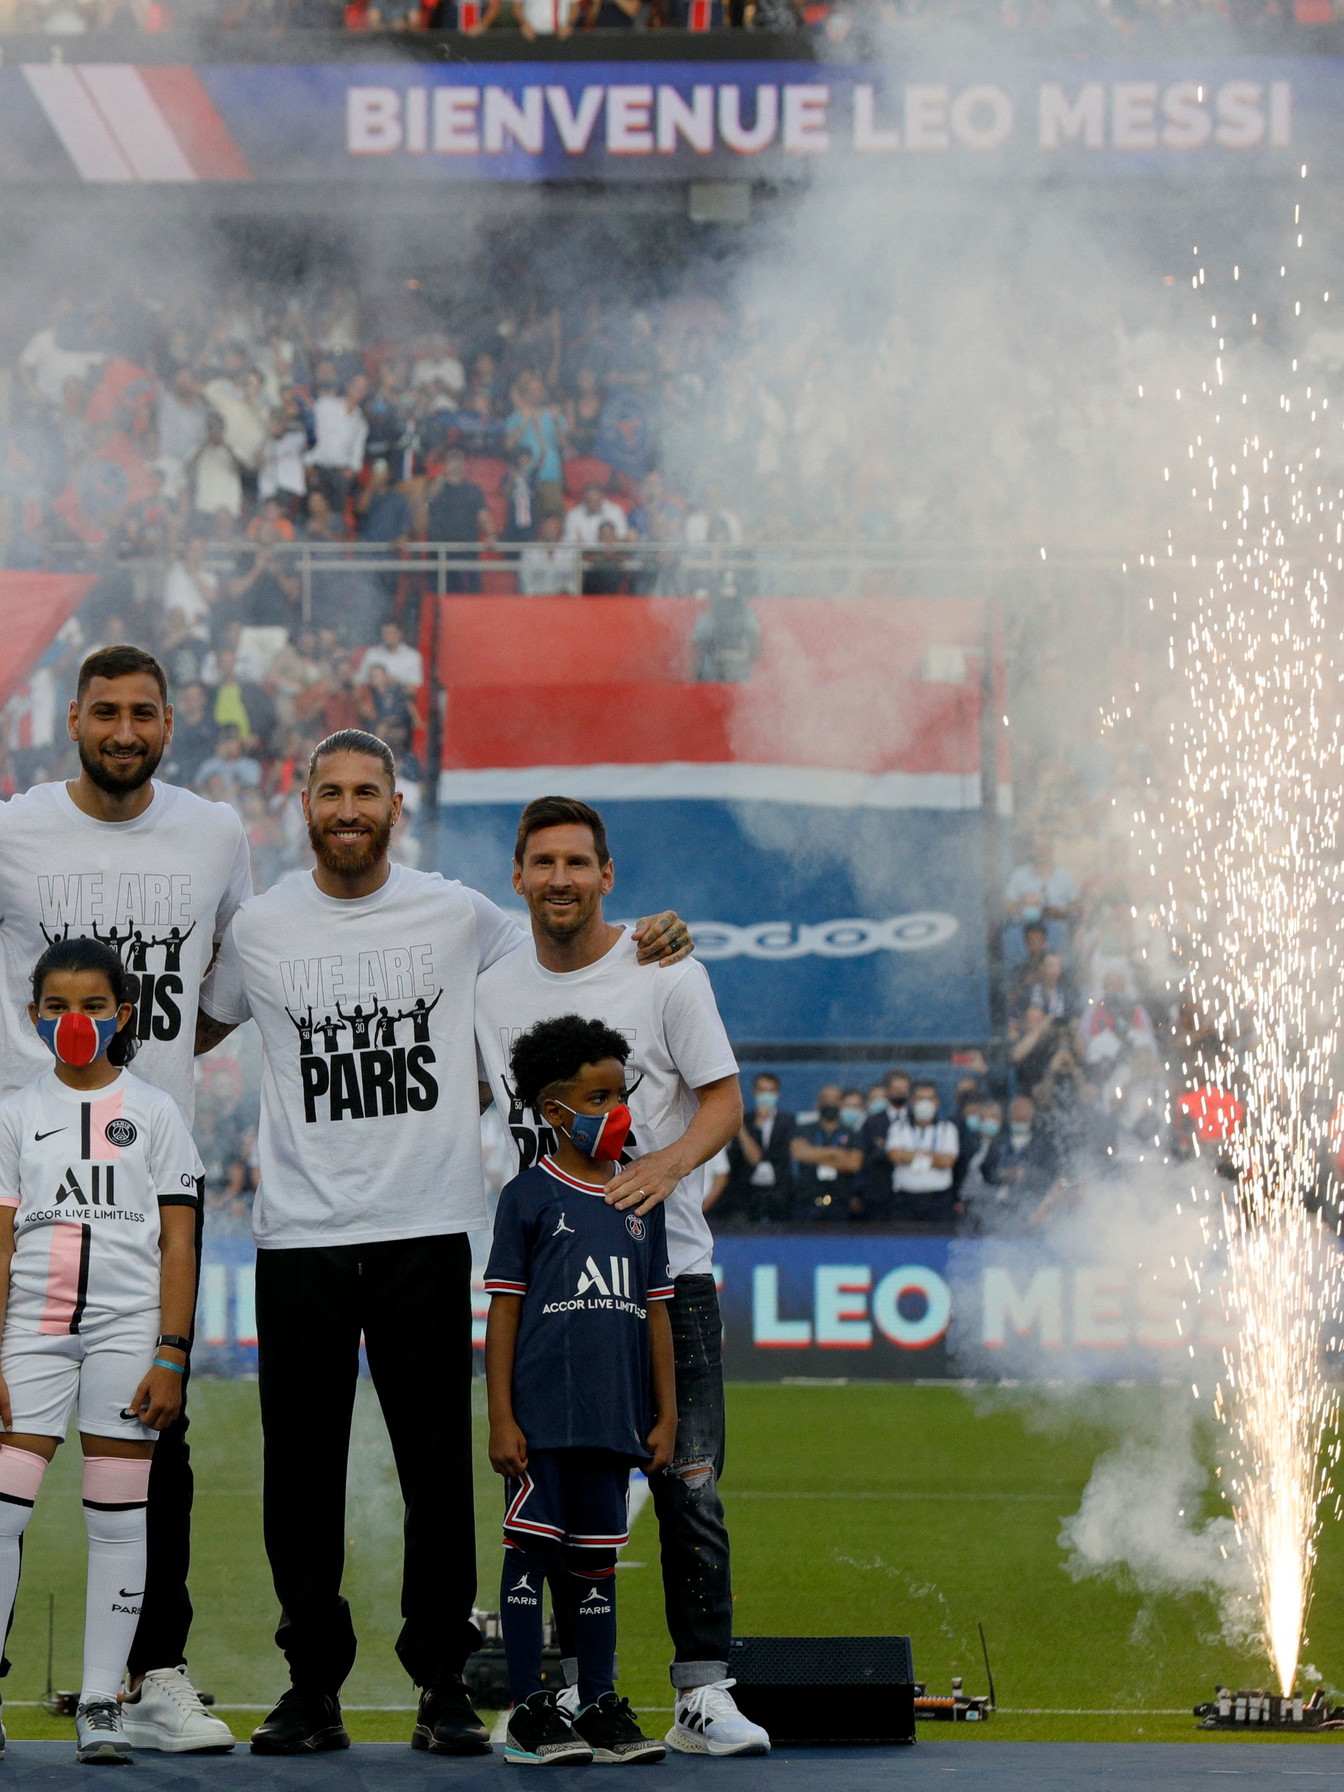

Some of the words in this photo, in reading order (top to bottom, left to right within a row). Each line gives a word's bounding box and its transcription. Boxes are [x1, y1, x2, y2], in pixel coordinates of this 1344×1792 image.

[345, 83, 831, 155] BIENVENUE
[856, 82, 1015, 153] LEO
[1039, 80, 1294, 150] MESSI
[37, 872, 104, 927] WE
[114, 873, 192, 926] ARE
[169, 943, 175, 954] 4
[279, 955, 348, 1011] WE
[358, 944, 435, 1004] ARE
[416, 1014, 422, 1025] 4
[355, 1022, 365, 1034] 30
[300, 1044, 440, 1124] PARIS
[24, 1209, 62, 1223] ACCOR
[65, 1209, 91, 1219] LIVE
[94, 1209, 145, 1223] LIMITLESS
[542, 1299, 585, 1315] ACCOR
[588, 1299, 614, 1310] LIVE
[752, 1264, 953, 1350] LEO
[981, 1265, 1256, 1350] MESS
[507, 1595, 538, 1606] PARIS
[579, 1605, 611, 1615] PARIS
